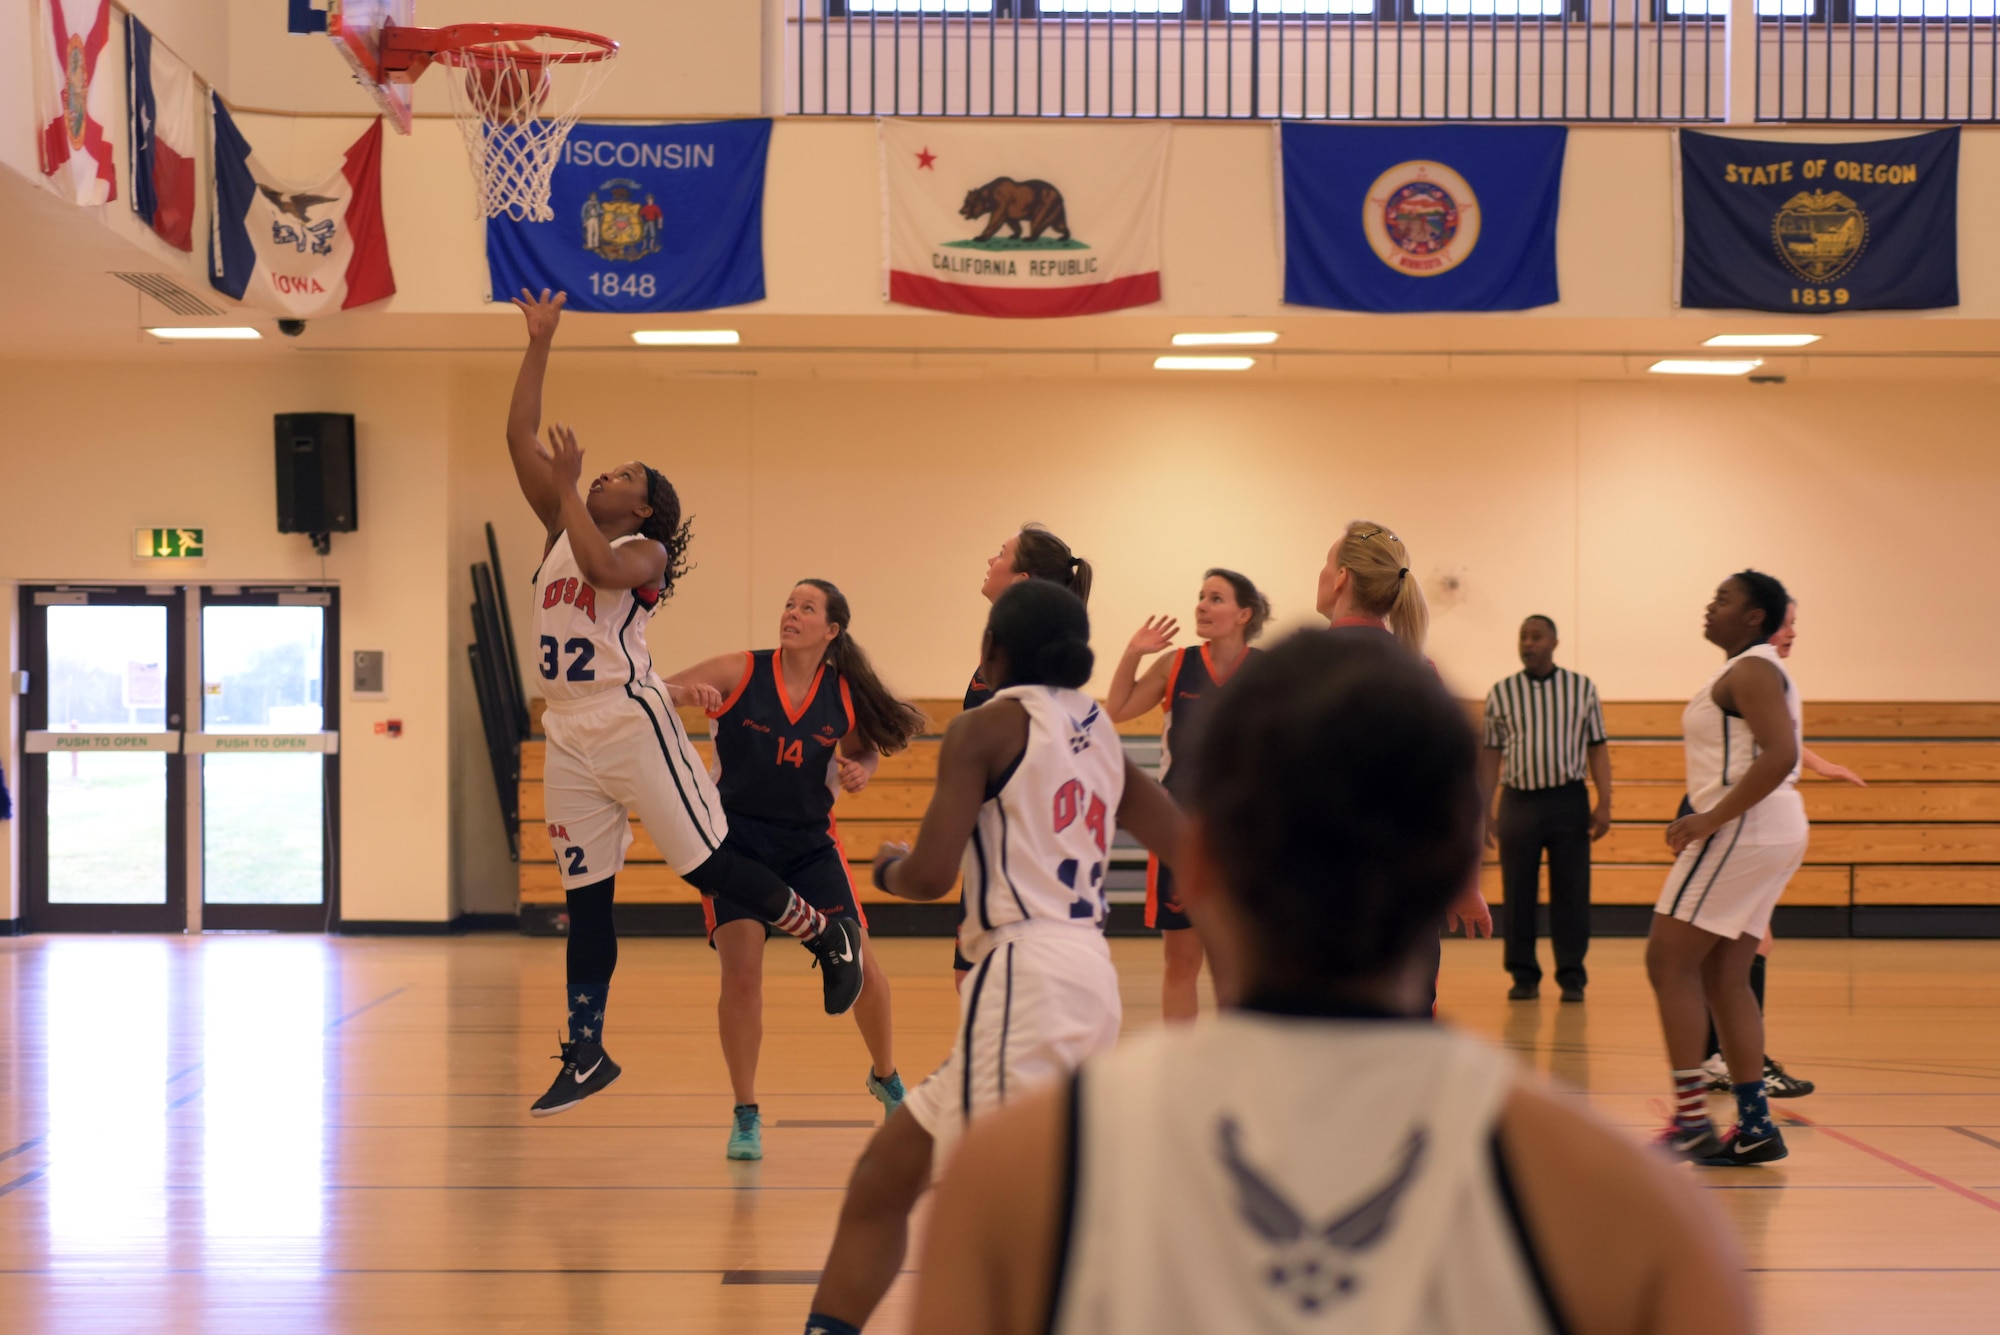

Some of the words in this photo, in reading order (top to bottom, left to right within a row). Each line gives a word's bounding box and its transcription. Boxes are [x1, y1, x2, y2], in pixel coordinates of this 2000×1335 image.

[560, 139, 715, 169] ISCONSIN
[1724, 160, 1794, 186] STATE
[1802, 159, 1828, 179] OF
[1833, 160, 1917, 185] OREGON
[932, 252, 1017, 277] CALIFORNIA
[1029, 257, 1098, 277] REPUBLIC
[271, 271, 326, 295] IOWA
[588, 271, 657, 298] 1848
[1790, 287, 1850, 306] 1859
[542, 576, 597, 625] USA
[538, 633, 596, 682] 32
[56, 736, 91, 748] PUSH
[94, 736, 111, 747] TO
[113, 736, 148, 747] OPEN
[215, 737, 250, 748] PUSH
[252, 737, 269, 748] TO
[272, 737, 307, 748] OPEN
[775, 736, 804, 768] 14
[548, 823, 571, 842] SA
[553, 845, 588, 876] 2
